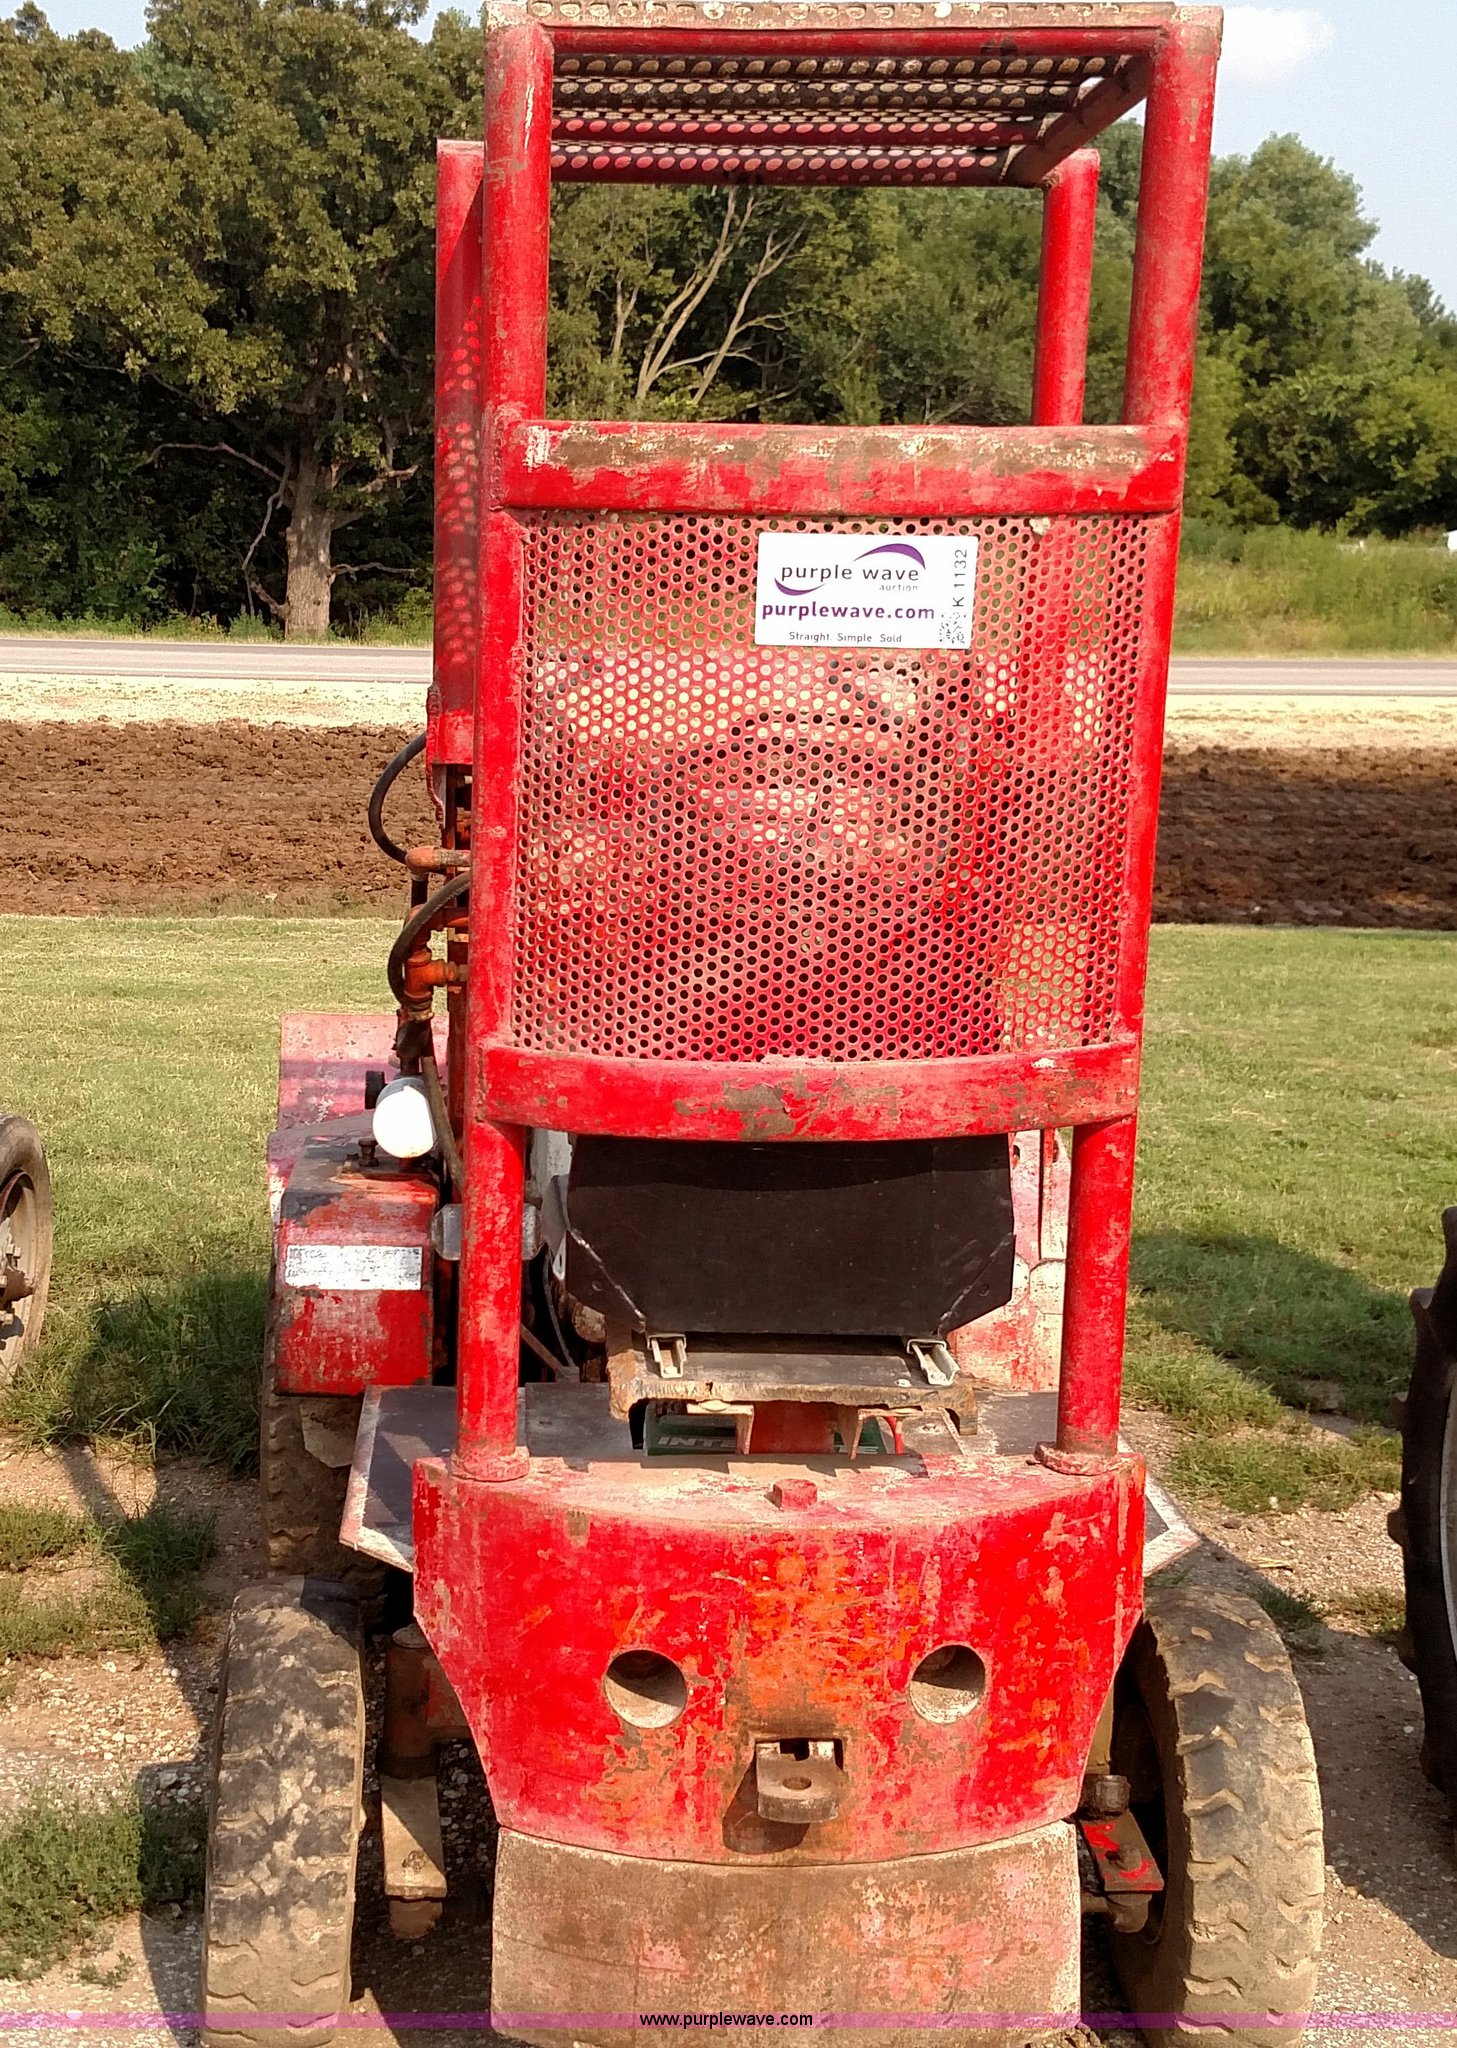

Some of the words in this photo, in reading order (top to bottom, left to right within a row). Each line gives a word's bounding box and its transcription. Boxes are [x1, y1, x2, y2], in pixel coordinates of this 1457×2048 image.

[781, 564, 853, 582] purple
[862, 568, 919, 581] wave
[878, 583, 919, 592] auction
[762, 601, 935, 621] purplewave.com
